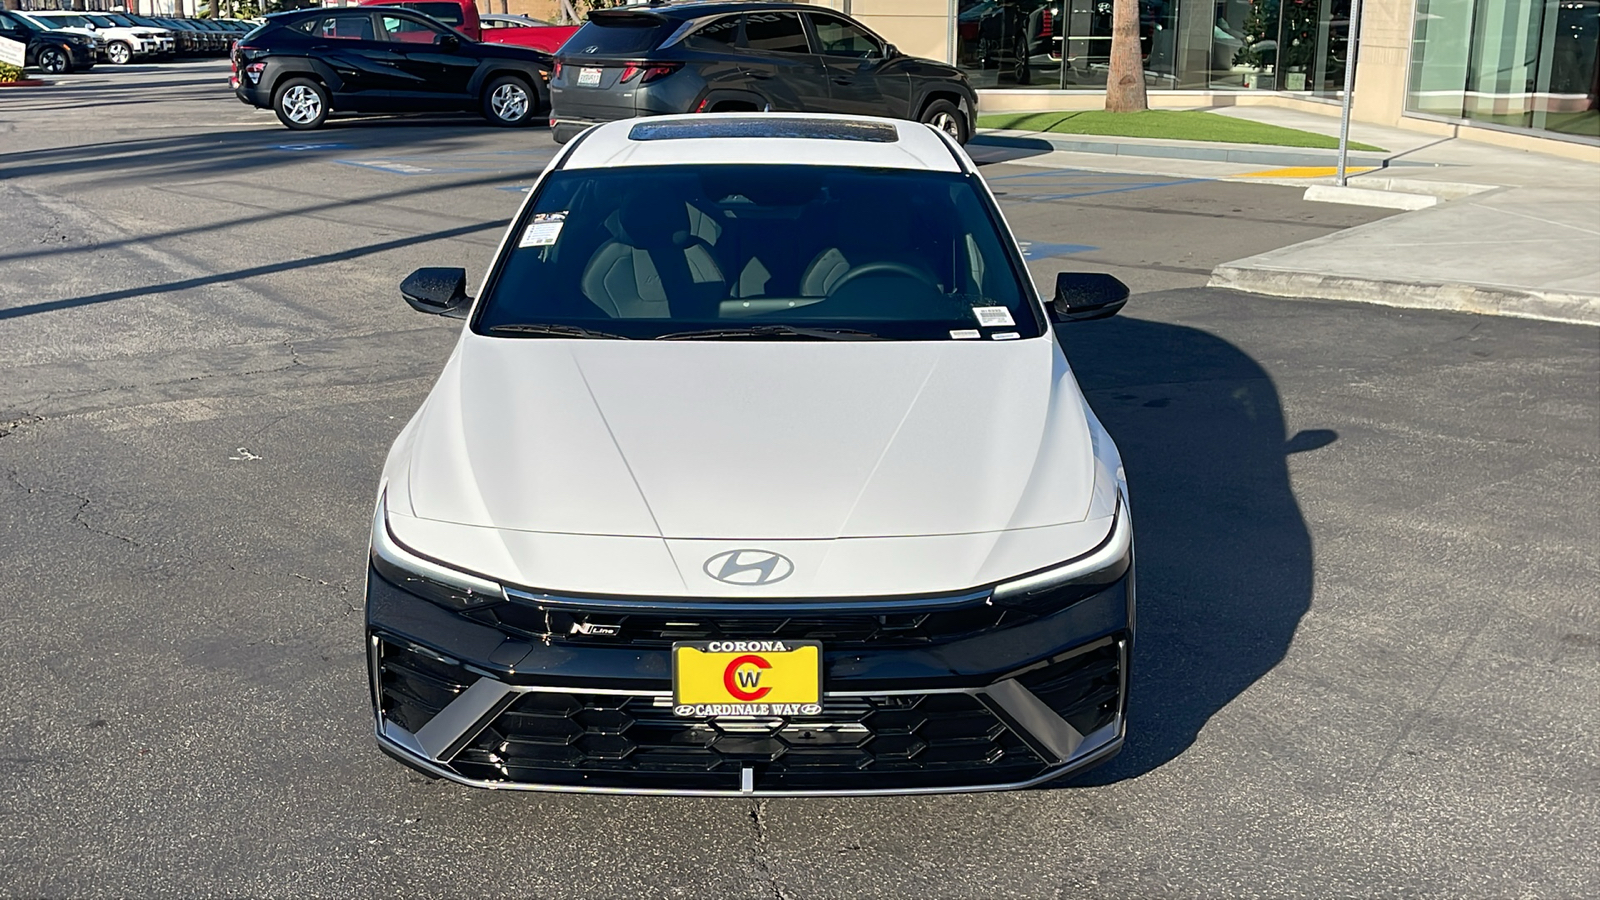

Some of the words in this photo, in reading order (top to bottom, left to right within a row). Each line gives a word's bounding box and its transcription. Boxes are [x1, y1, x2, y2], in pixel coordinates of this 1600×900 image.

[708, 641, 787, 652] CORONA
[695, 704, 770, 716] CARDINALE
[772, 704, 801, 716] WAY
